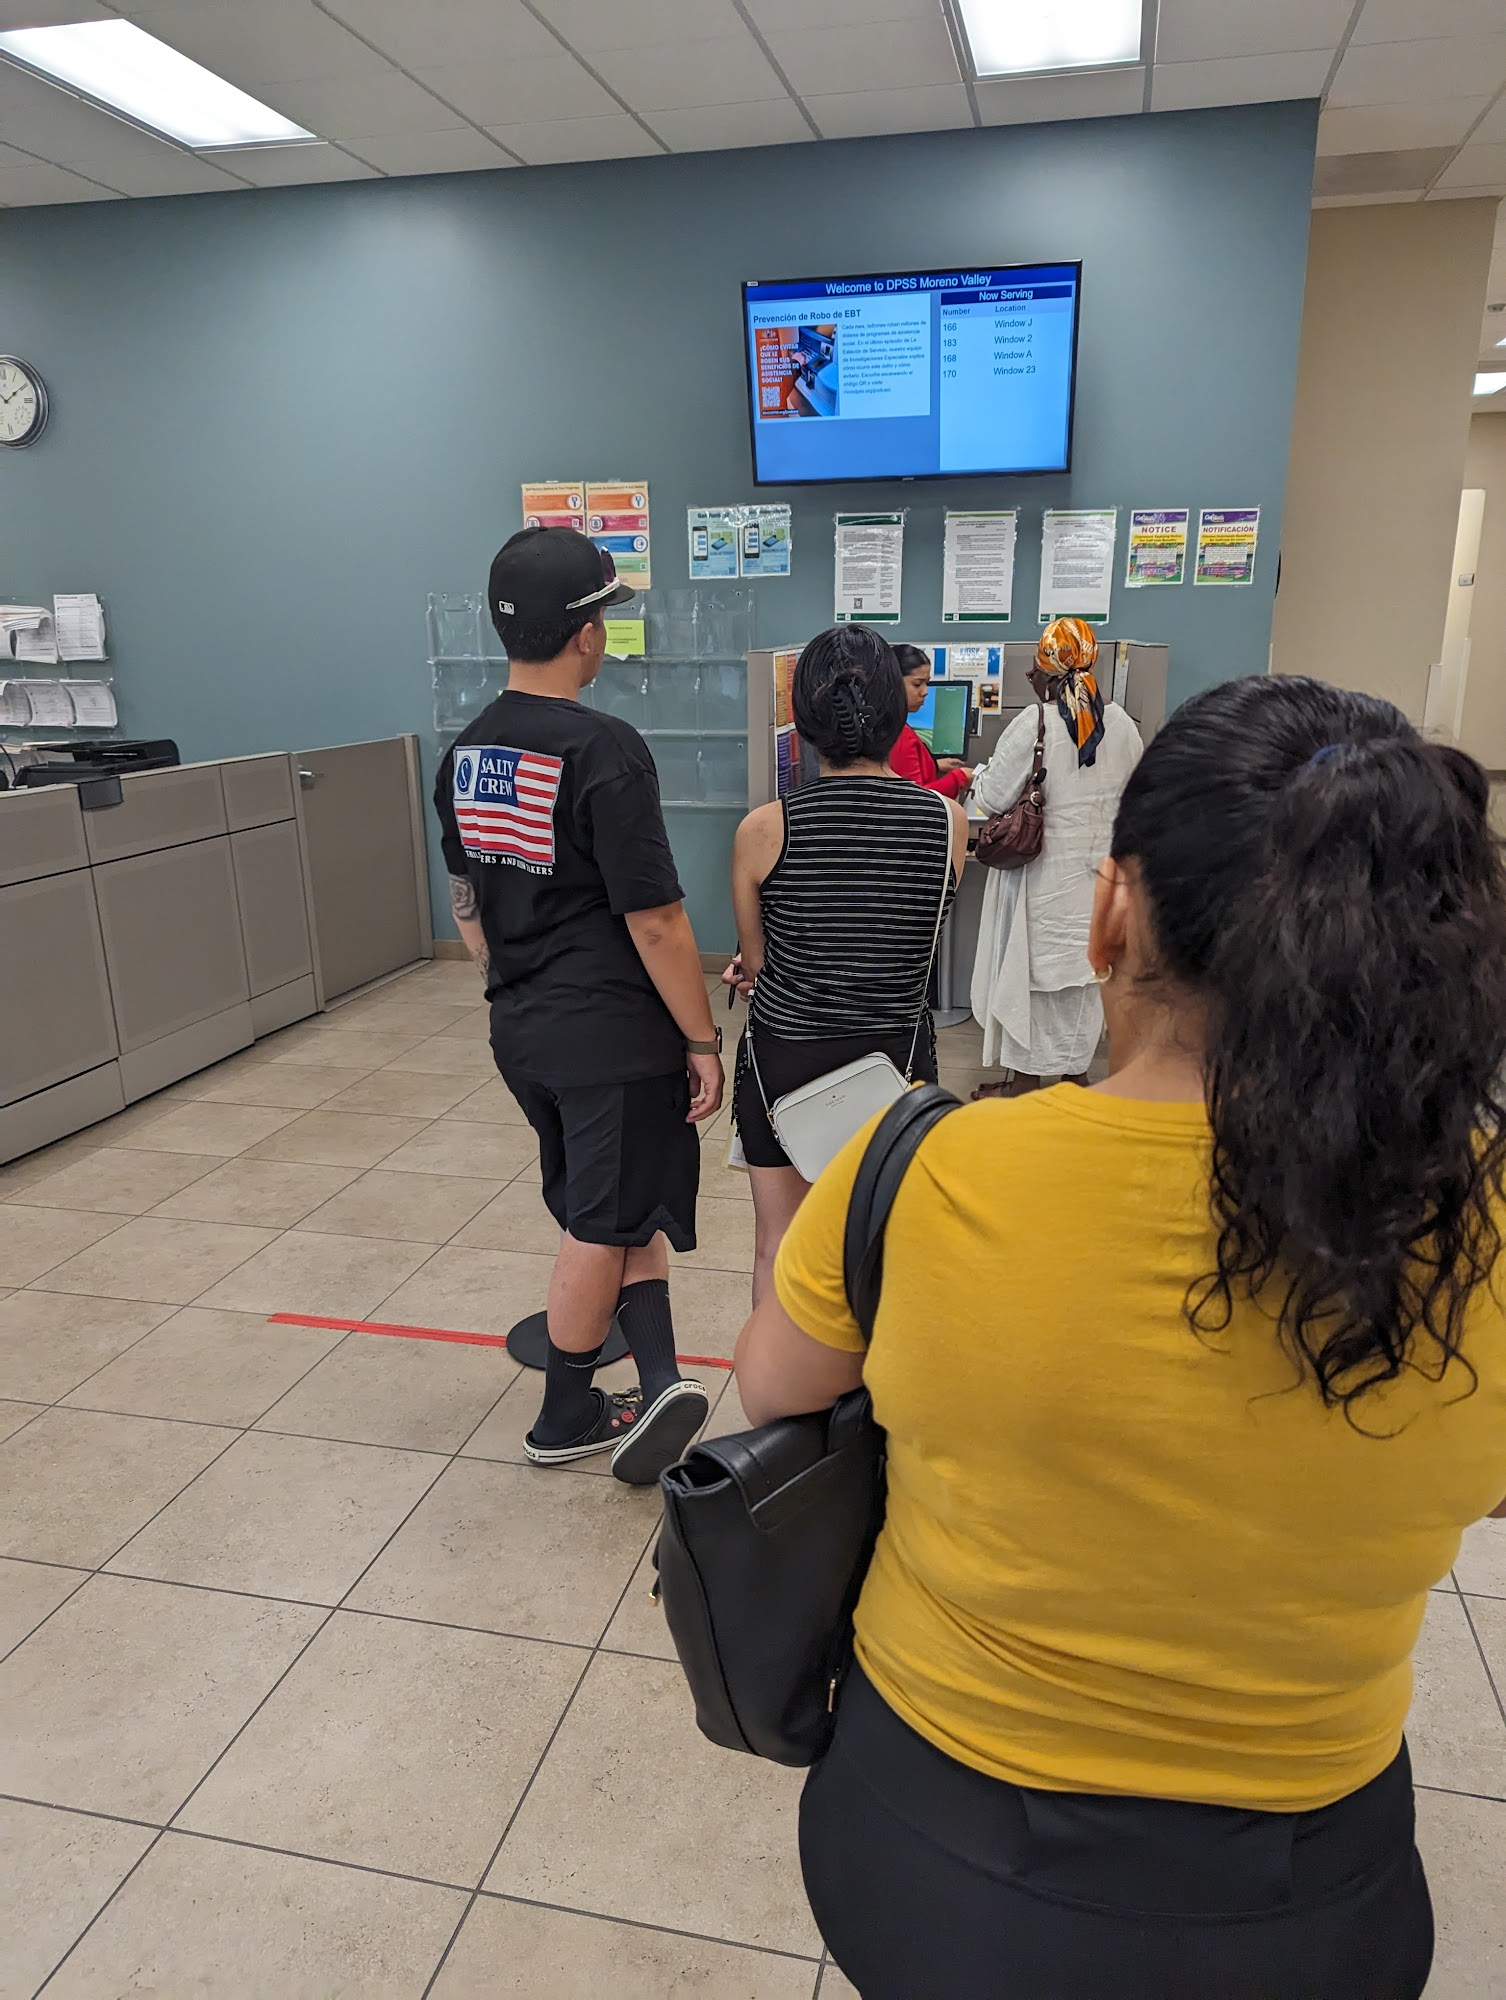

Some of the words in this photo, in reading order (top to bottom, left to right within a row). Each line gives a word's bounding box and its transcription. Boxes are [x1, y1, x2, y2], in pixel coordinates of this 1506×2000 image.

[826, 282, 872, 294] Welcome
[874, 281, 883, 291] to
[887, 278, 917, 290] DPSS
[920, 276, 958, 289] Moreno
[961, 274, 992, 287] Valley
[979, 291, 998, 301] Now
[1001, 289, 1033, 300] Serving
[754, 313, 796, 324] Prevención
[798, 312, 808, 320] de
[810, 311, 831, 320] Robo
[833, 310, 843, 319] de
[844, 309, 861, 318] EBT
[943, 308, 970, 316] Number
[995, 304, 1026, 312] Location
[943, 323, 957, 332] 166
[995, 319, 1026, 328] Window
[1028, 318, 1033, 327] J
[943, 338, 957, 347] 183
[994, 335, 1025, 344] Window
[1027, 334, 1033, 342] 2
[943, 354, 957, 363] 168
[994, 351, 1025, 360] Window
[1026, 350, 1032, 358] A
[943, 370, 957, 378] 170
[993, 367, 1024, 376] Window
[1026, 365, 1036, 374] 23
[960, 648, 980, 656] KIOSK
[481, 758, 514, 777] SALTY
[480, 778, 512, 797] CREW
